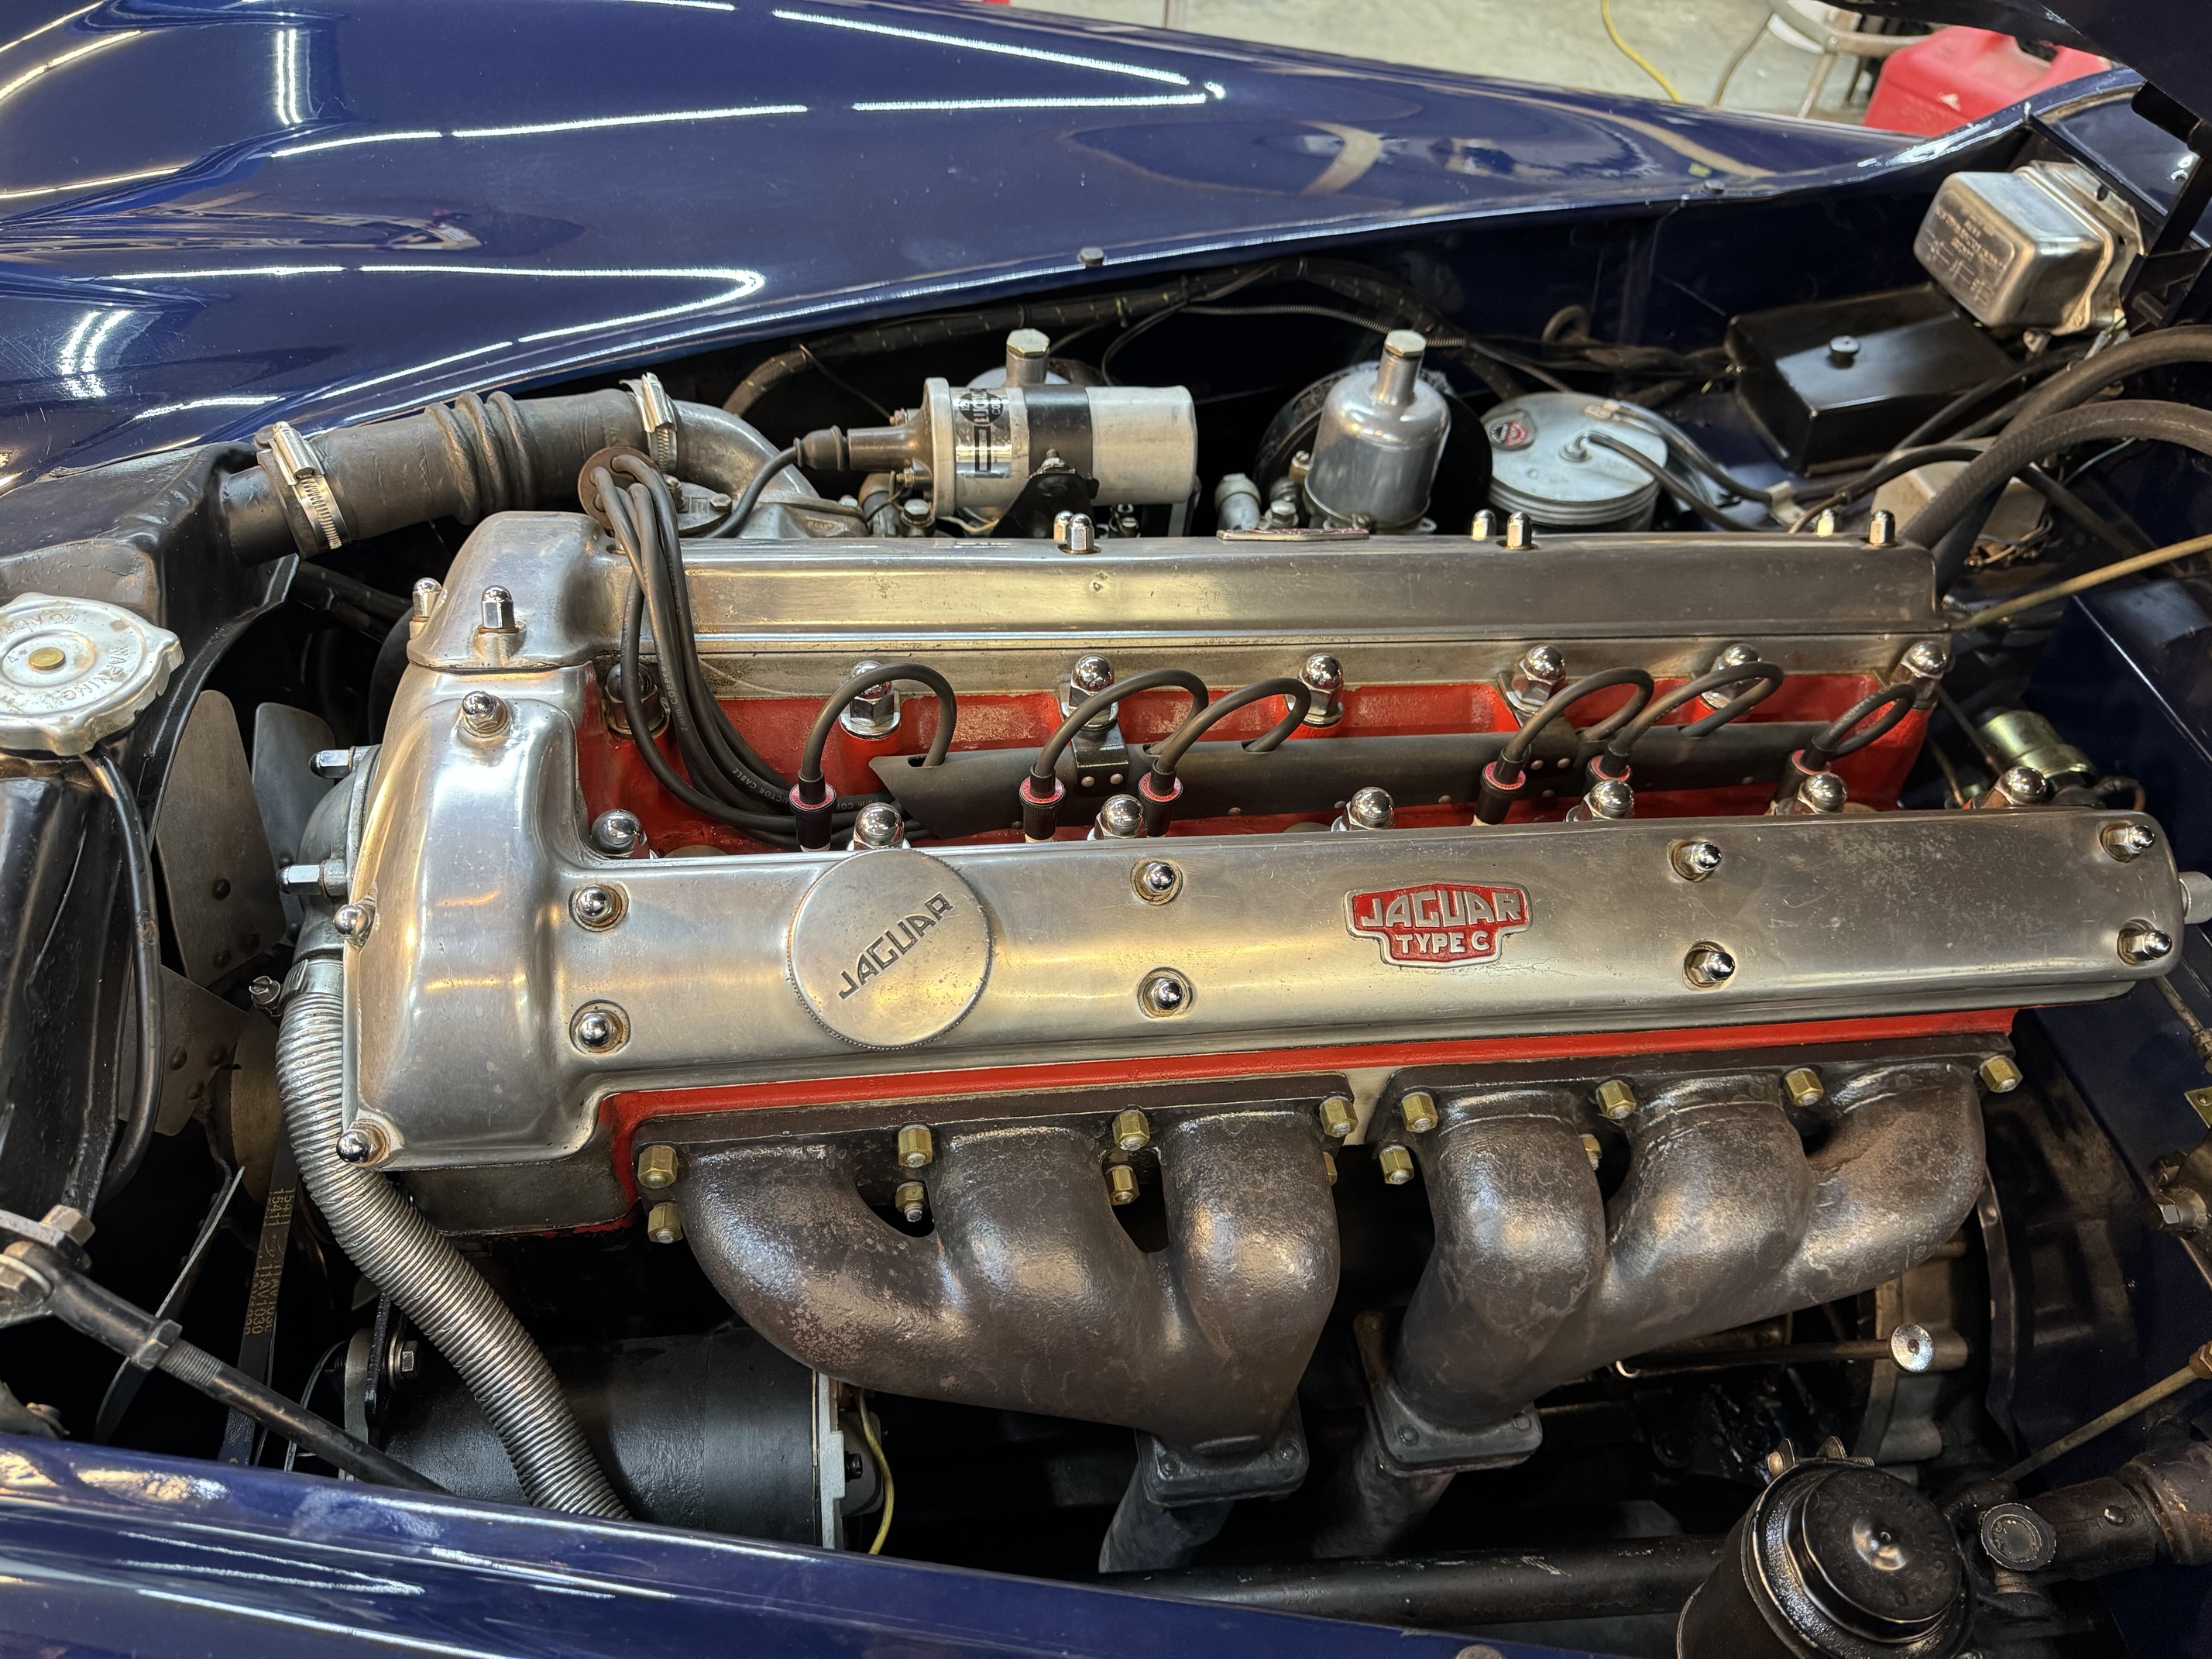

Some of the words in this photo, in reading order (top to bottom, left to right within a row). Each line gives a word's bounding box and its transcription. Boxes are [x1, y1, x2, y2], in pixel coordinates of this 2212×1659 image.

[661, 666, 678, 705] COPPER
[676, 709, 689, 731] 7mm
[731, 768, 757, 789] CABLE
[1362, 889, 1522, 929] JAGUAR
[839, 891, 954, 1000] JAGUAR
[1396, 932, 1465, 954] TYPE
[1471, 929, 1490, 951] C
